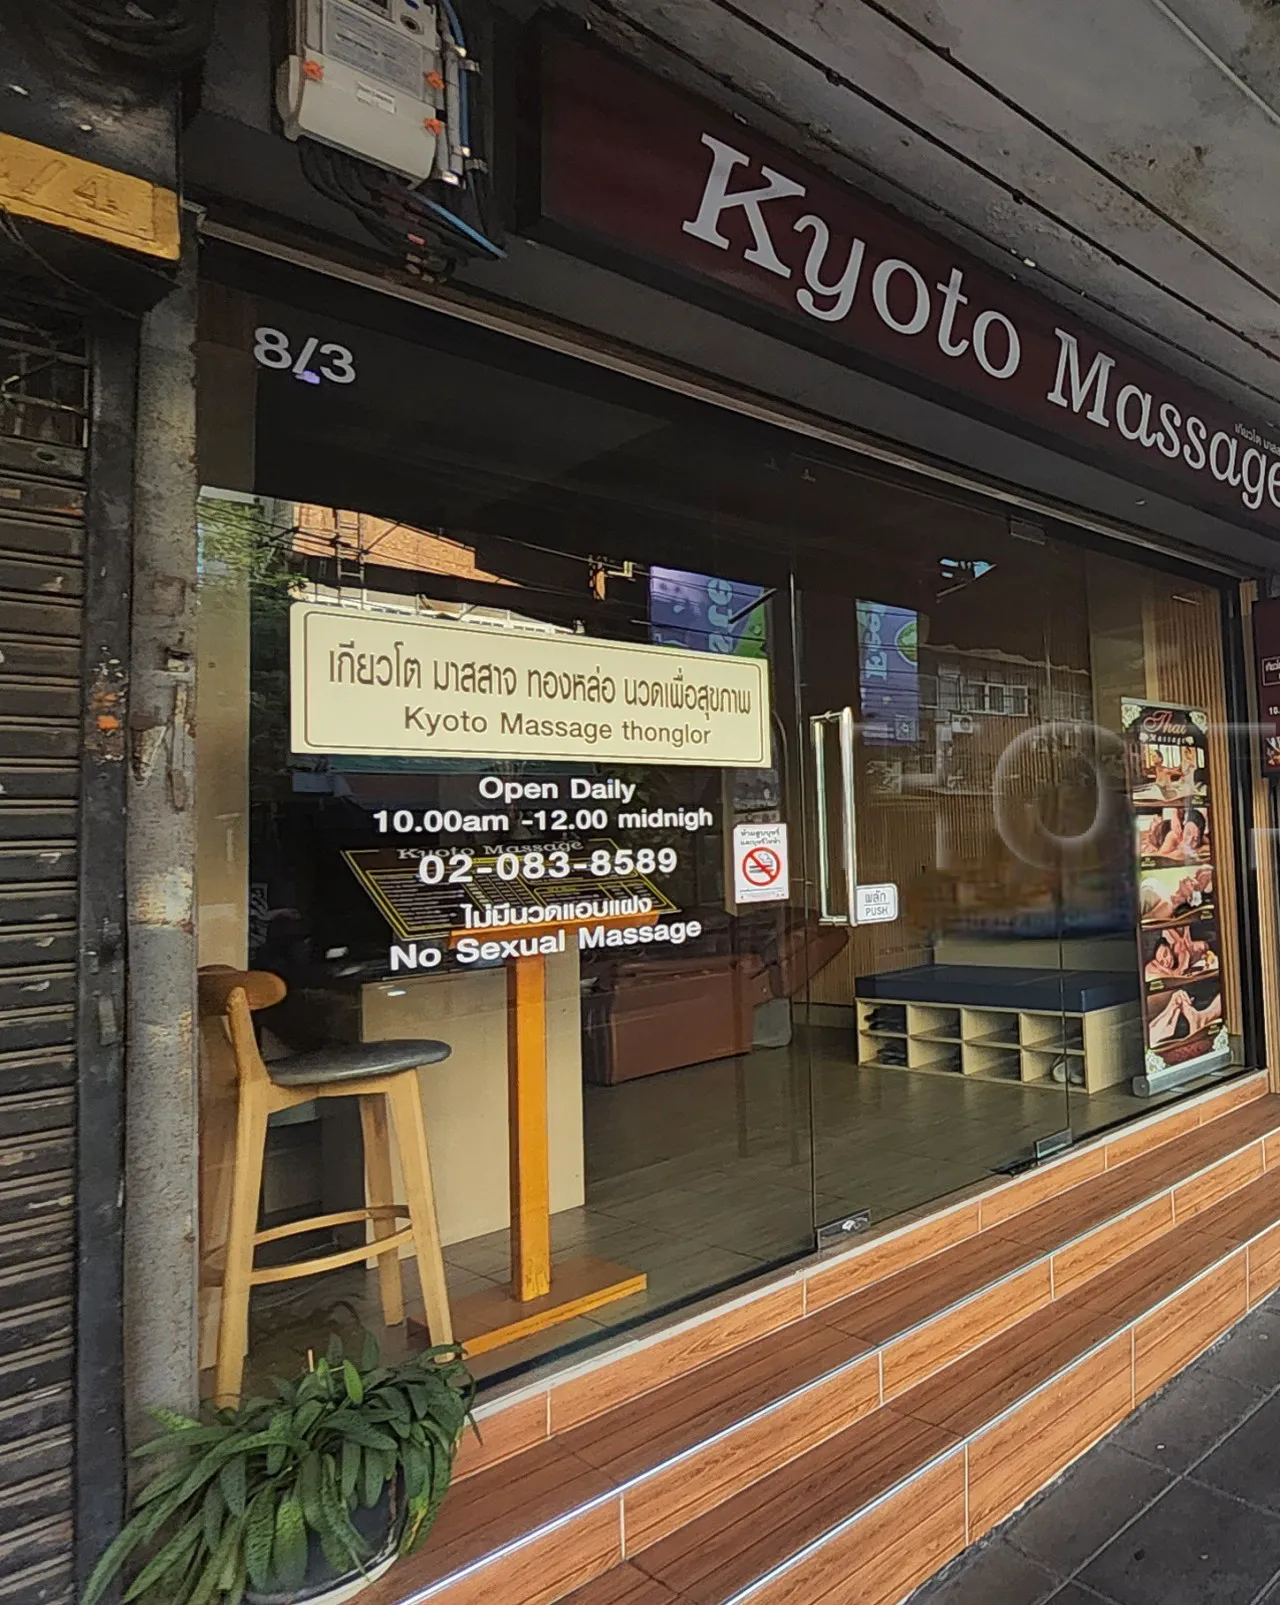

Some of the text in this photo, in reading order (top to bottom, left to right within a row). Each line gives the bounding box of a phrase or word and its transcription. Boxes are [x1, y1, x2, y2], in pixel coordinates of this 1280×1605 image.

[682, 133, 1021, 379] Kyoto
[253, 327, 357, 384] 8/3
[329, 641, 422, 689] เกียวโต
[526, 664, 616, 704] ทองหล่อ
[623, 667, 752, 721] นวดเพื่อสุขภาพ
[404, 705, 712, 748] Kyoto Massage thonglor
[1143, 710, 1187, 735] Thai
[479, 776, 636, 804] Open Daily
[373, 809, 509, 833] 10.00am
[418, 847, 678, 885] 02-083-8589
[460, 895, 653, 929] ไม่มีนวดแอบแฝง
[864, 889, 887, 904] ผลัก
[865, 906, 889, 917] PUSH
[389, 918, 703, 971] No Sexual Massage
